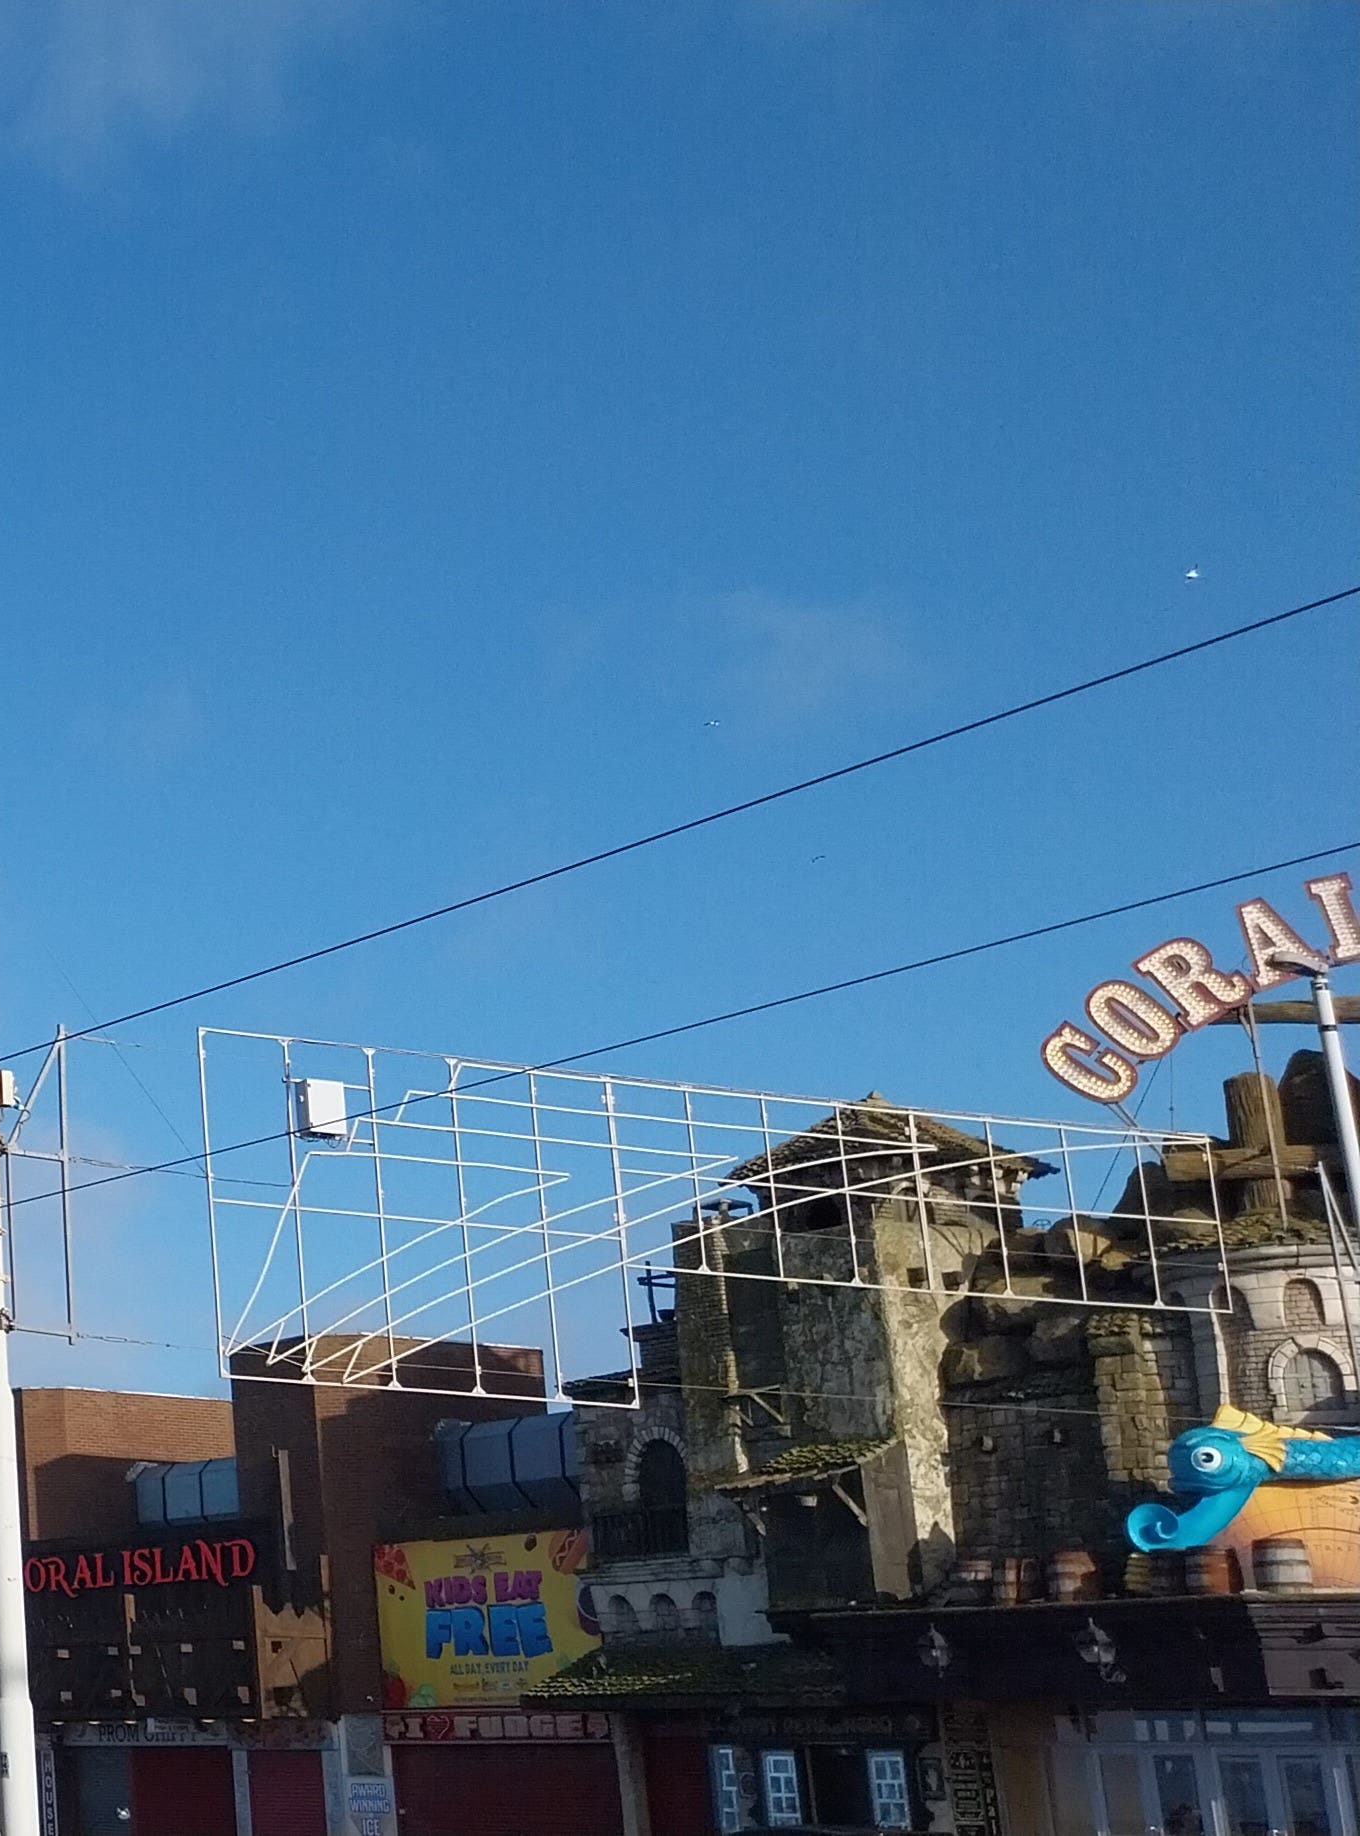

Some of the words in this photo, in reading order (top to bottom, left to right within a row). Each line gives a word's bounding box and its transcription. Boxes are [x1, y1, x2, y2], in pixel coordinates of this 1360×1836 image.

[23, 1552, 116, 1598] ORAL
[121, 1538, 256, 1586] ISLAND
[424, 1575, 488, 1608] KIDS
[493, 1570, 543, 1602] EAT
[425, 1601, 554, 1659] FREE
[98, 1724, 140, 1742] PROM
[406, 1716, 424, 1739] I
[454, 1714, 584, 1739] FUDGE
[44, 1760, 55, 1835] HOUSE
[351, 1783, 386, 1798] AWARD
[349, 1799, 390, 1813] WINNING
[361, 1818, 381, 1836] ICE
